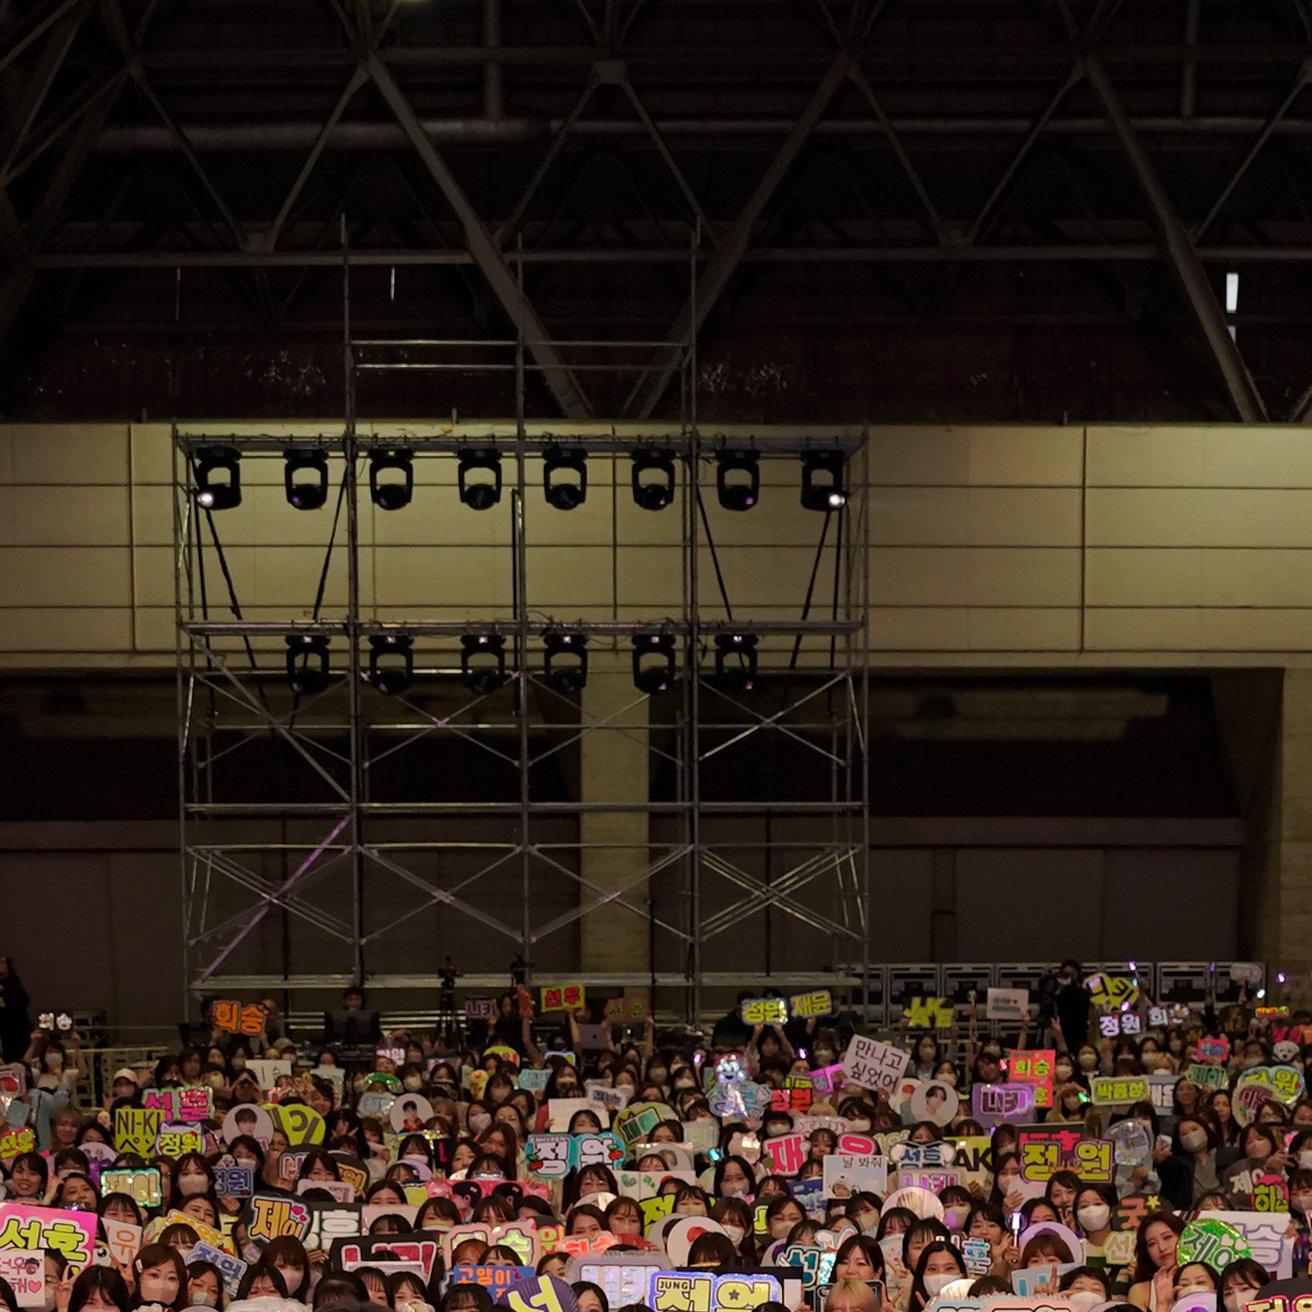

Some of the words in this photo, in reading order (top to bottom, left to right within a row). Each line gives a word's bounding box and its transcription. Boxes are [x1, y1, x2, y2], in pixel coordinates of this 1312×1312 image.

[214, 1002, 265, 1034] 희승
[1099, 1014, 1142, 1036] 정원
[855, 1039, 903, 1068] 만나고
[849, 1060, 899, 1090] 싶었어
[117, 1111, 161, 1137] NI-KI
[159, 1132, 201, 1158] 정원
[534, 1139, 621, 1180] 정원
[859, 1155, 885, 1169] 봐줘
[1022, 1143, 1115, 1183] 정원
[252, 1200, 305, 1240] 제이
[458, 1268, 512, 1286] 고양이
[660, 1281, 688, 1291] JUNG
